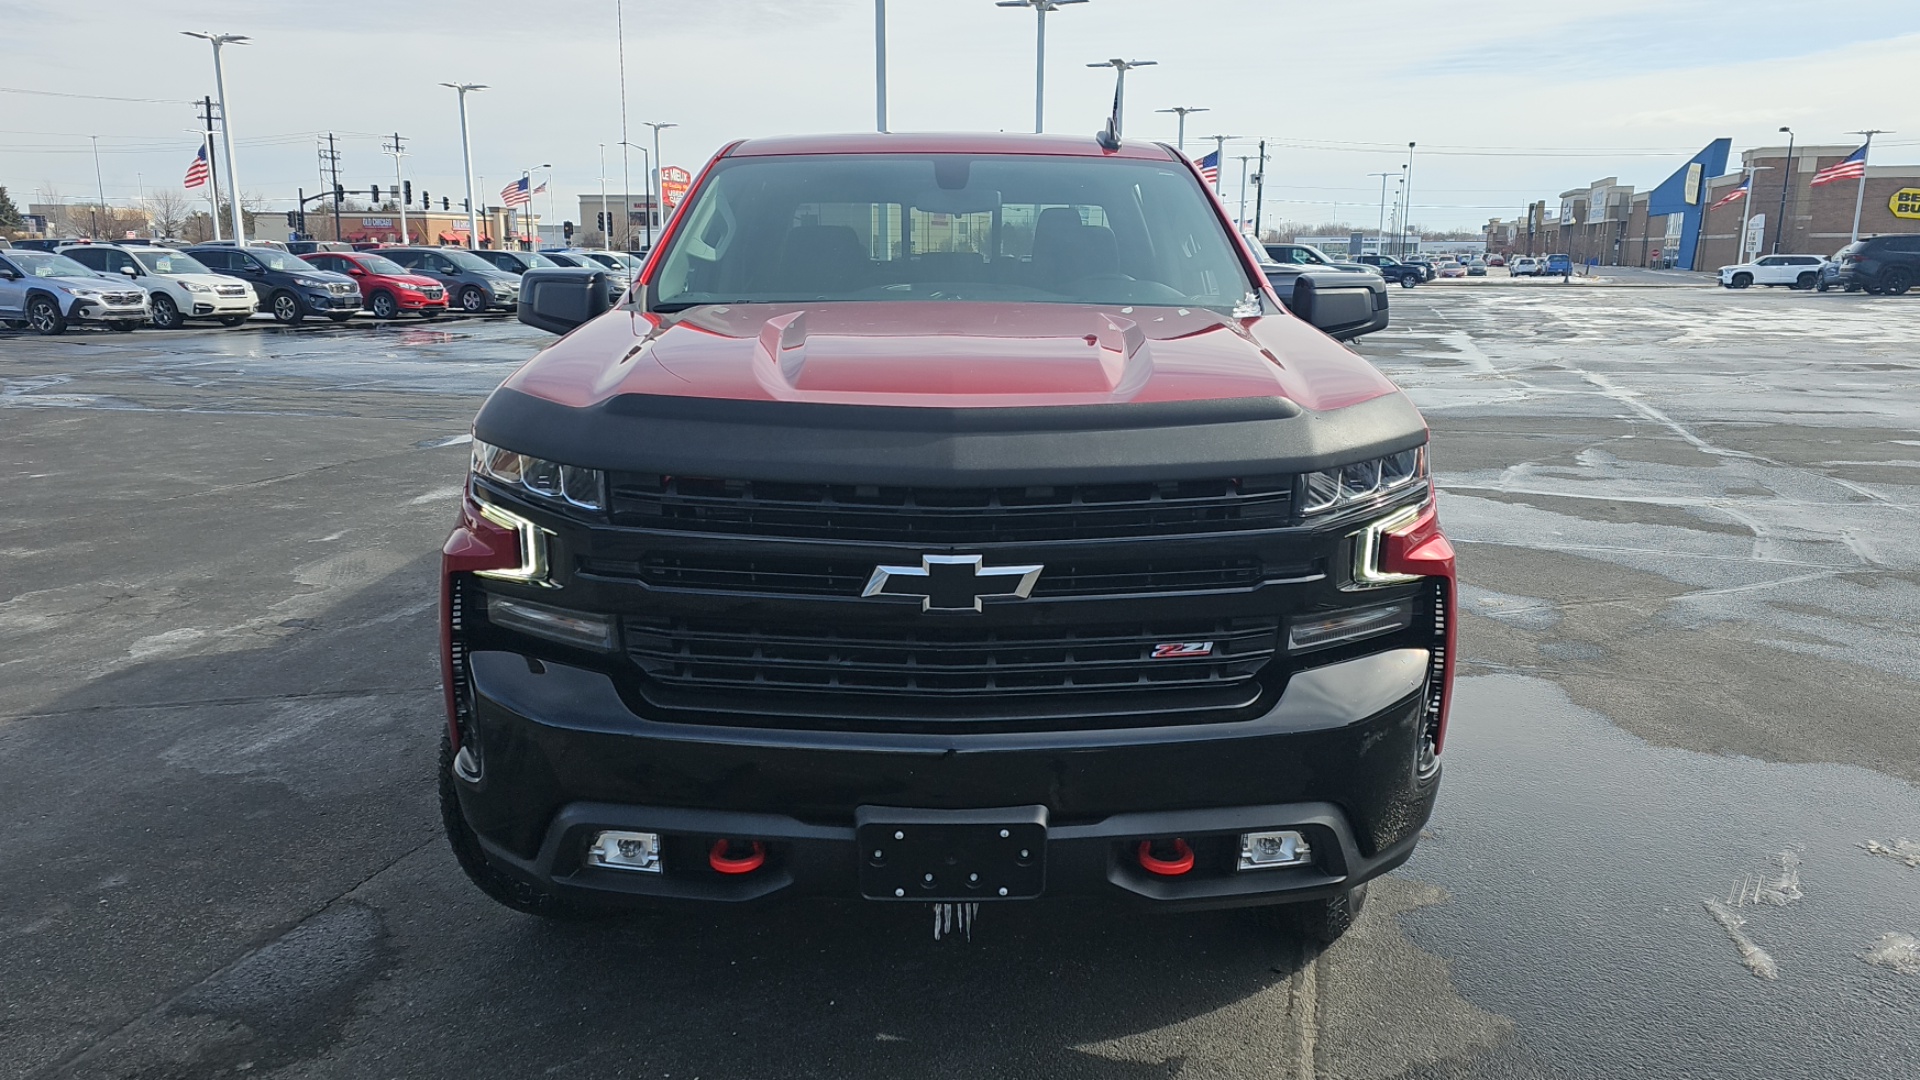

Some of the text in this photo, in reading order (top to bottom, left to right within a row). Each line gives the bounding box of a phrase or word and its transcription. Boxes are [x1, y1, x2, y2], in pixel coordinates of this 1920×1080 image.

[1898, 193, 1920, 202] BE
[1897, 203, 1920, 213] BU
[362, 218, 392, 226] OLD CHICAGO
